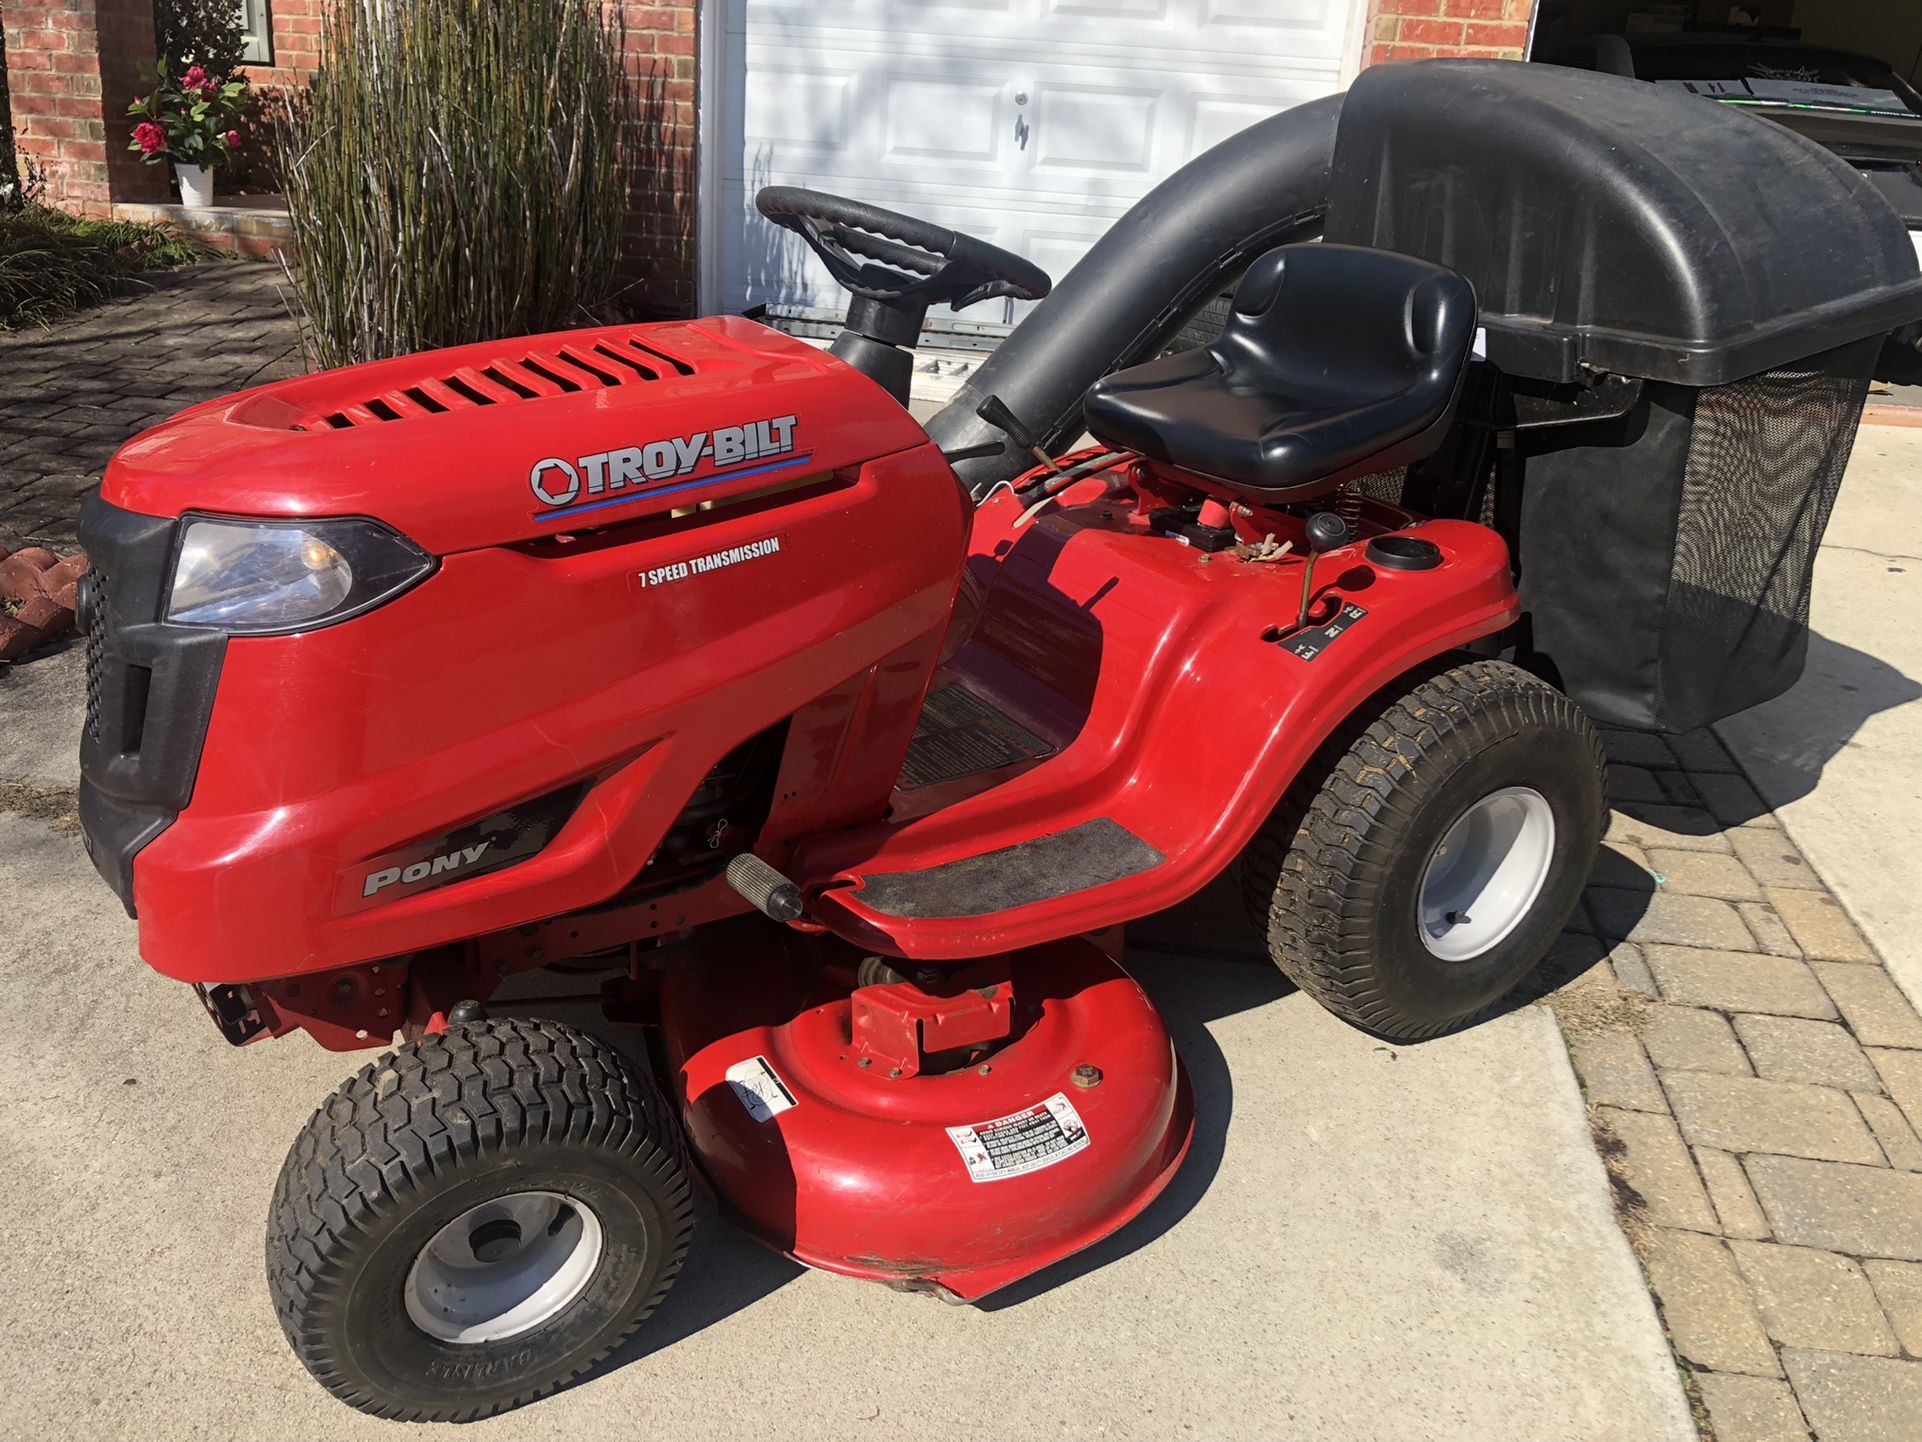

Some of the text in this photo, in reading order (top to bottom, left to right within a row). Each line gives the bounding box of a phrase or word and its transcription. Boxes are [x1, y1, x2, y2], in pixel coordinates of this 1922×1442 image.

[578, 415, 797, 494] TROY-BILT
[638, 537, 780, 588] 7 SPEED TRANSMISSION
[1324, 628, 1340, 638] N
[363, 841, 490, 897] PONY
[994, 1110, 1035, 1127] DANGER
